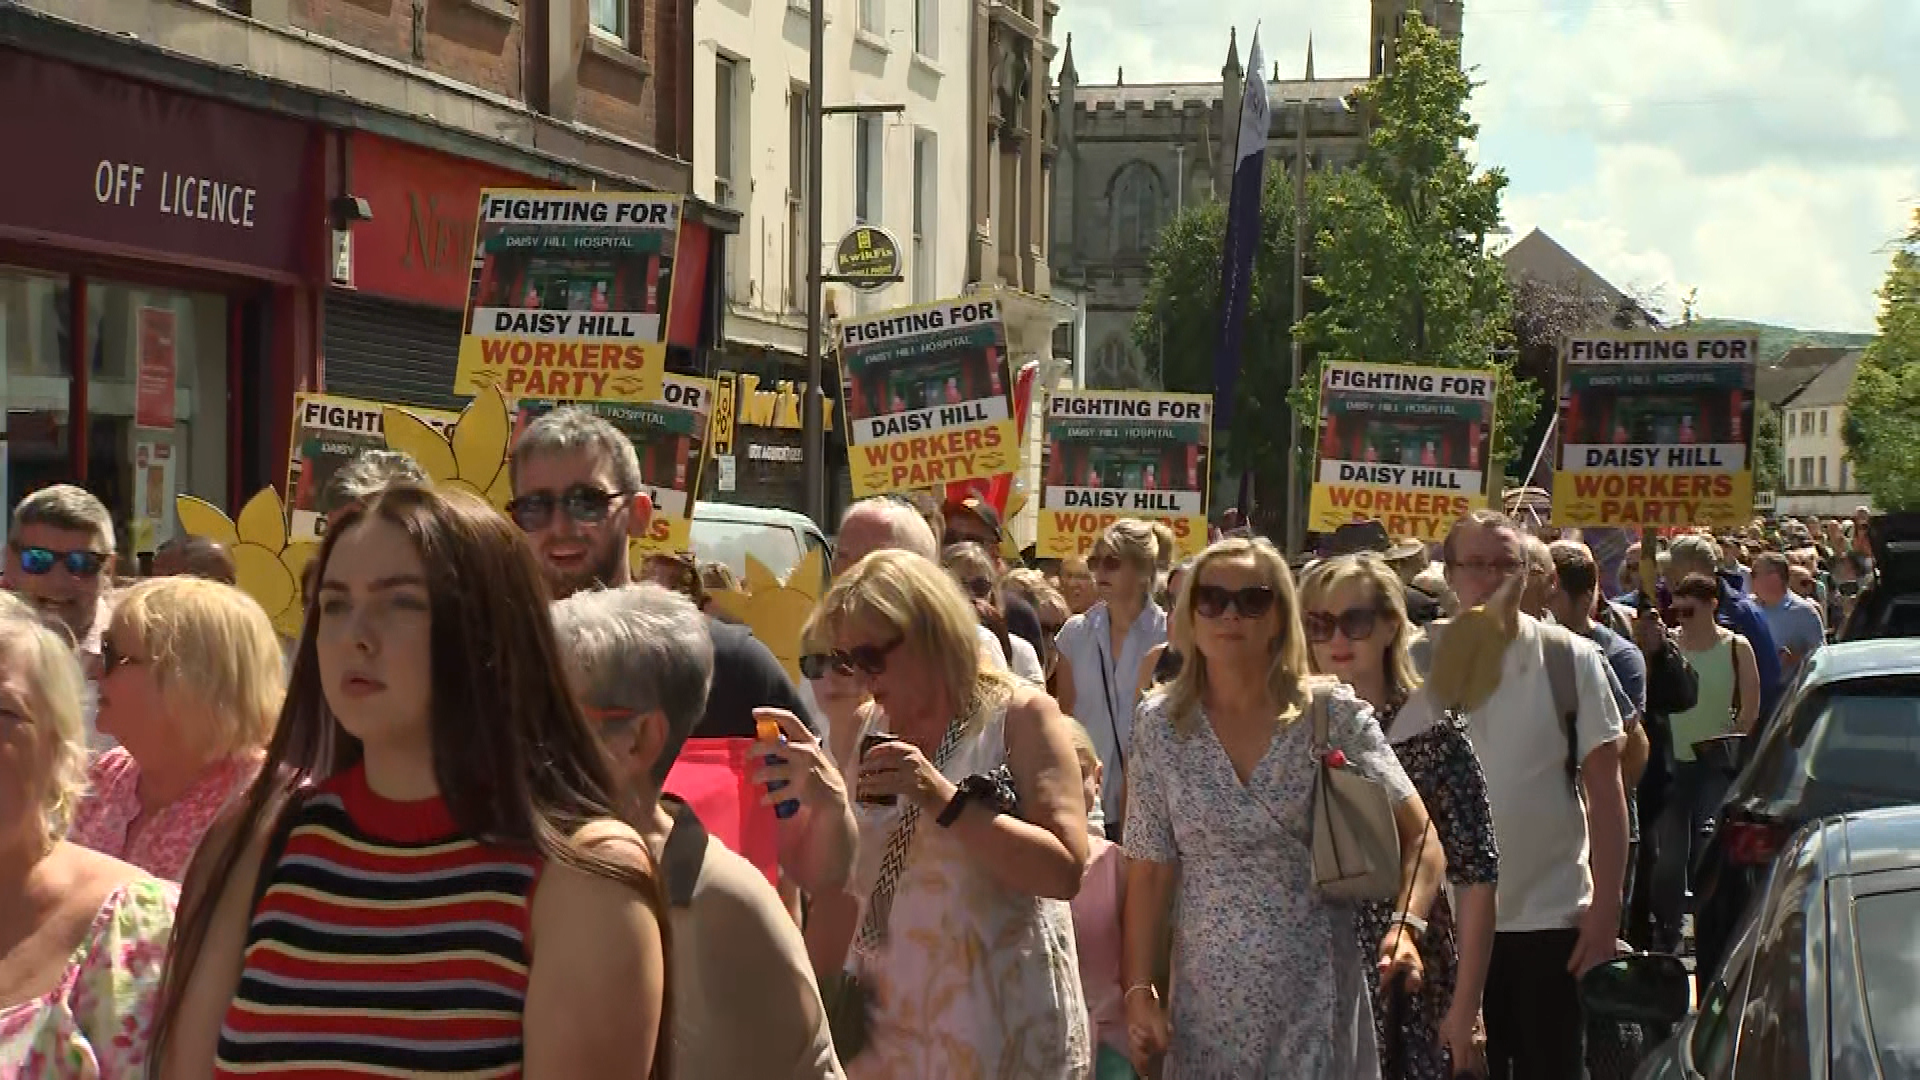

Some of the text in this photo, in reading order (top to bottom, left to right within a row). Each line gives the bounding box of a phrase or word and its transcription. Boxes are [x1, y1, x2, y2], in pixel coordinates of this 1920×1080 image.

[95, 159, 257, 228] OFF LICENCE
[489, 199, 669, 225] FIGHTING FOR
[506, 236, 634, 248] DAISY HILL HOSPITAL
[495, 312, 636, 337] DAISY HILL
[844, 302, 995, 343] FIGHTING FOR
[481, 340, 645, 371] WORKERS
[921, 335, 973, 353] HOSPITAL
[1571, 339, 1748, 360] FIGHTING FOR
[504, 369, 611, 397] PARTY
[664, 384, 701, 407] OR
[1331, 369, 1486, 397] FIGHTING FOR
[304, 403, 384, 433] FIGHTI
[872, 403, 988, 438] DAISY HILL
[1052, 397, 1201, 419] FIGHTING FOR
[1125, 428, 1177, 439] HOSPITAL
[865, 426, 1001, 468] WORKERS
[1586, 447, 1723, 467] DAISY HILL
[892, 454, 977, 487] PARTY
[1339, 464, 1461, 489] DAISY HILL
[1574, 475, 1734, 498] WORKERS
[1064, 489, 1181, 511] DAISY HILL
[1328, 485, 1470, 517] WORKERS
[1600, 501, 1702, 523] PARTY
